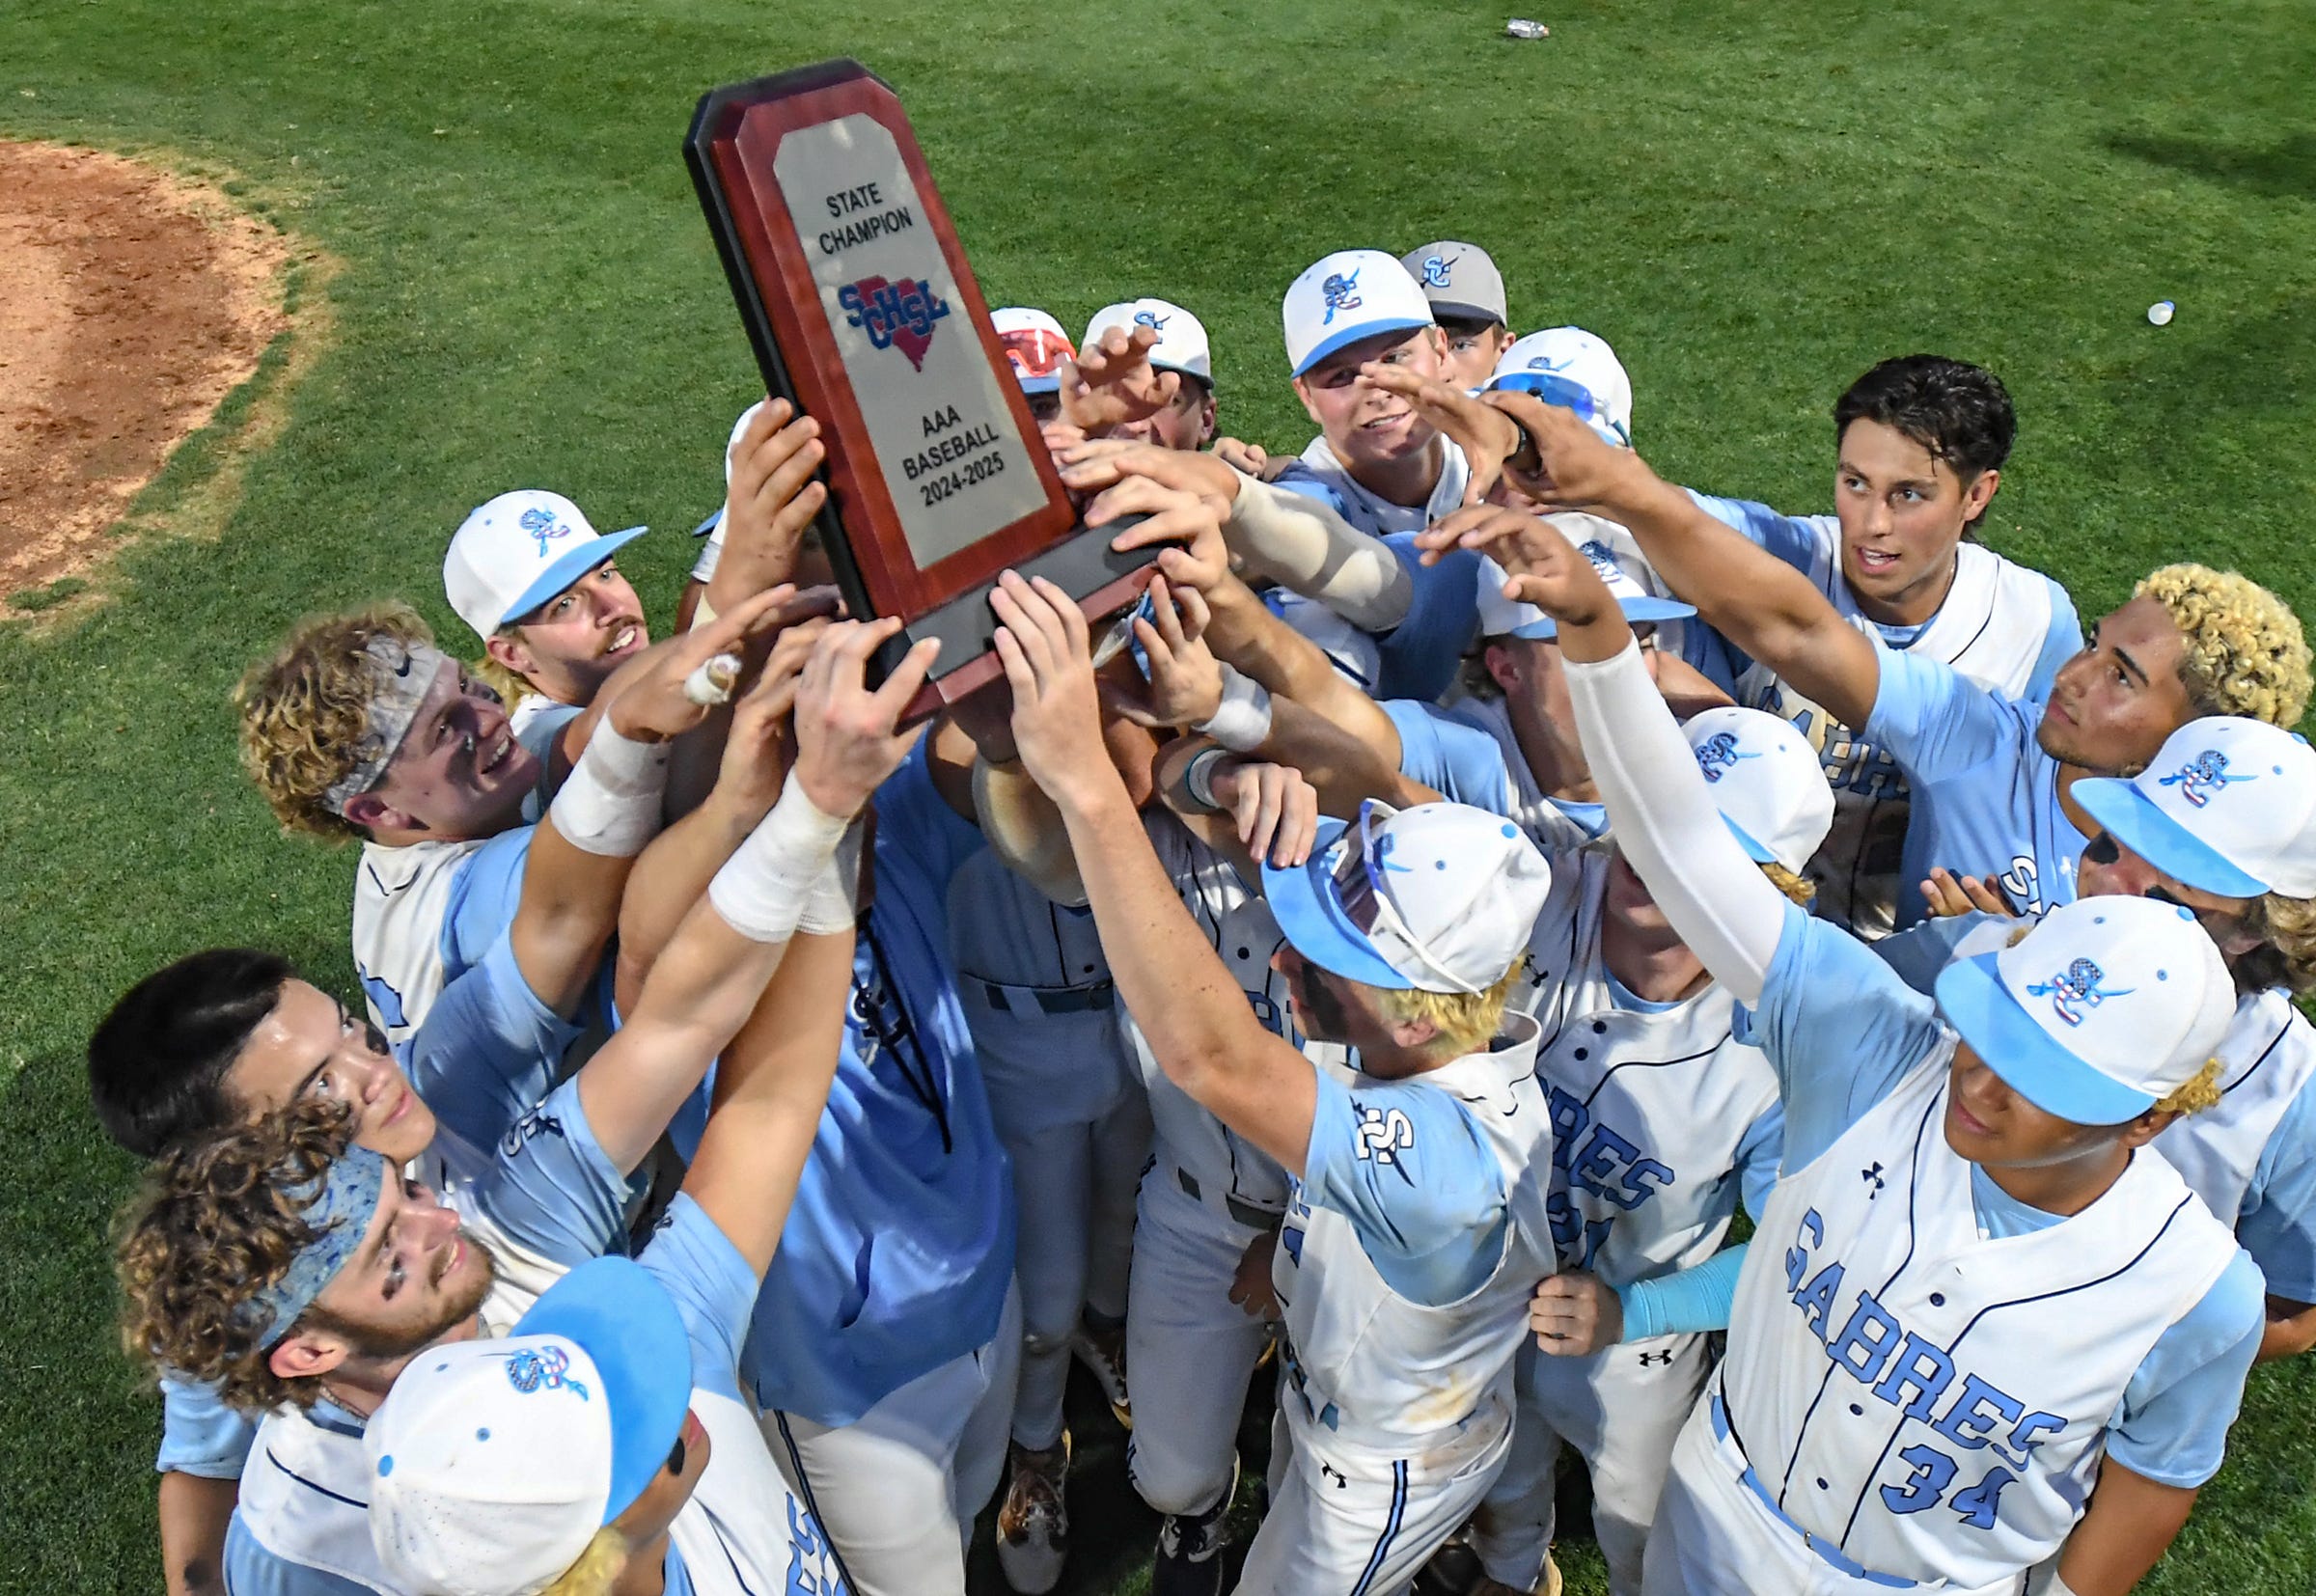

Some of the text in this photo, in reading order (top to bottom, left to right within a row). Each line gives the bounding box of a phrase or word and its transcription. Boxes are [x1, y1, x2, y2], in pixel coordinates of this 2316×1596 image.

[825, 182, 883, 218] STATE
[818, 206, 914, 256] CHAMPION
[1422, 256, 1451, 288] SC
[838, 279, 951, 350] SCHSL
[922, 404, 962, 438] AAA
[902, 422, 1001, 481] BASEBALL
[919, 454, 1006, 508] 2024-2025
[1534, 1071, 1675, 1211] RES
[1785, 1206, 2069, 1472] SABRES
[1879, 1444, 2018, 1530] 34
